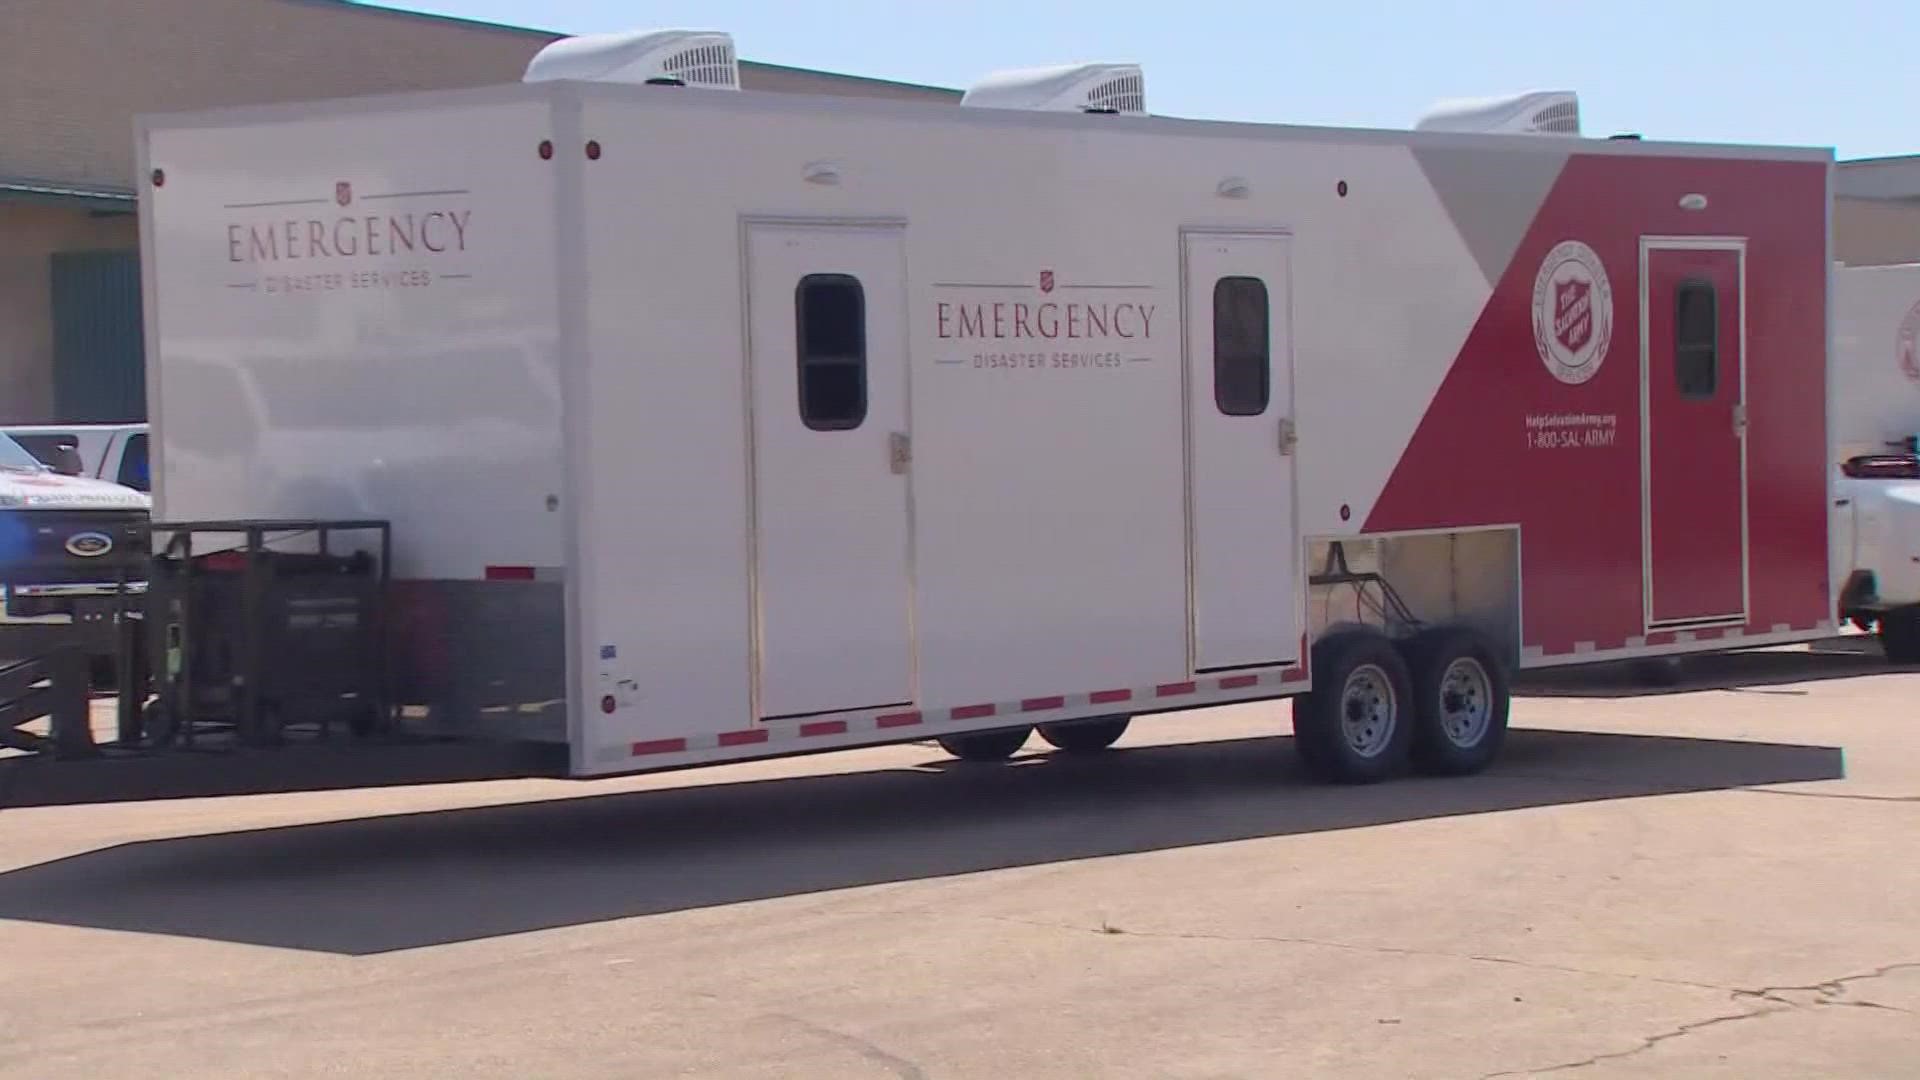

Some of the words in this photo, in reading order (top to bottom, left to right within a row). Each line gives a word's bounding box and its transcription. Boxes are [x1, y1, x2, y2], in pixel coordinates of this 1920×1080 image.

[228, 210, 471, 262] EMERGENCY
[263, 273, 343, 293] DISASTER
[352, 270, 431, 288] SERVICES
[938, 302, 1155, 339] EMERGENCY
[973, 352, 1046, 369] DISASTER
[1053, 352, 1121, 368] SERVICES
[1527, 430, 1615, 448] 1-800-SAL-ARMY
